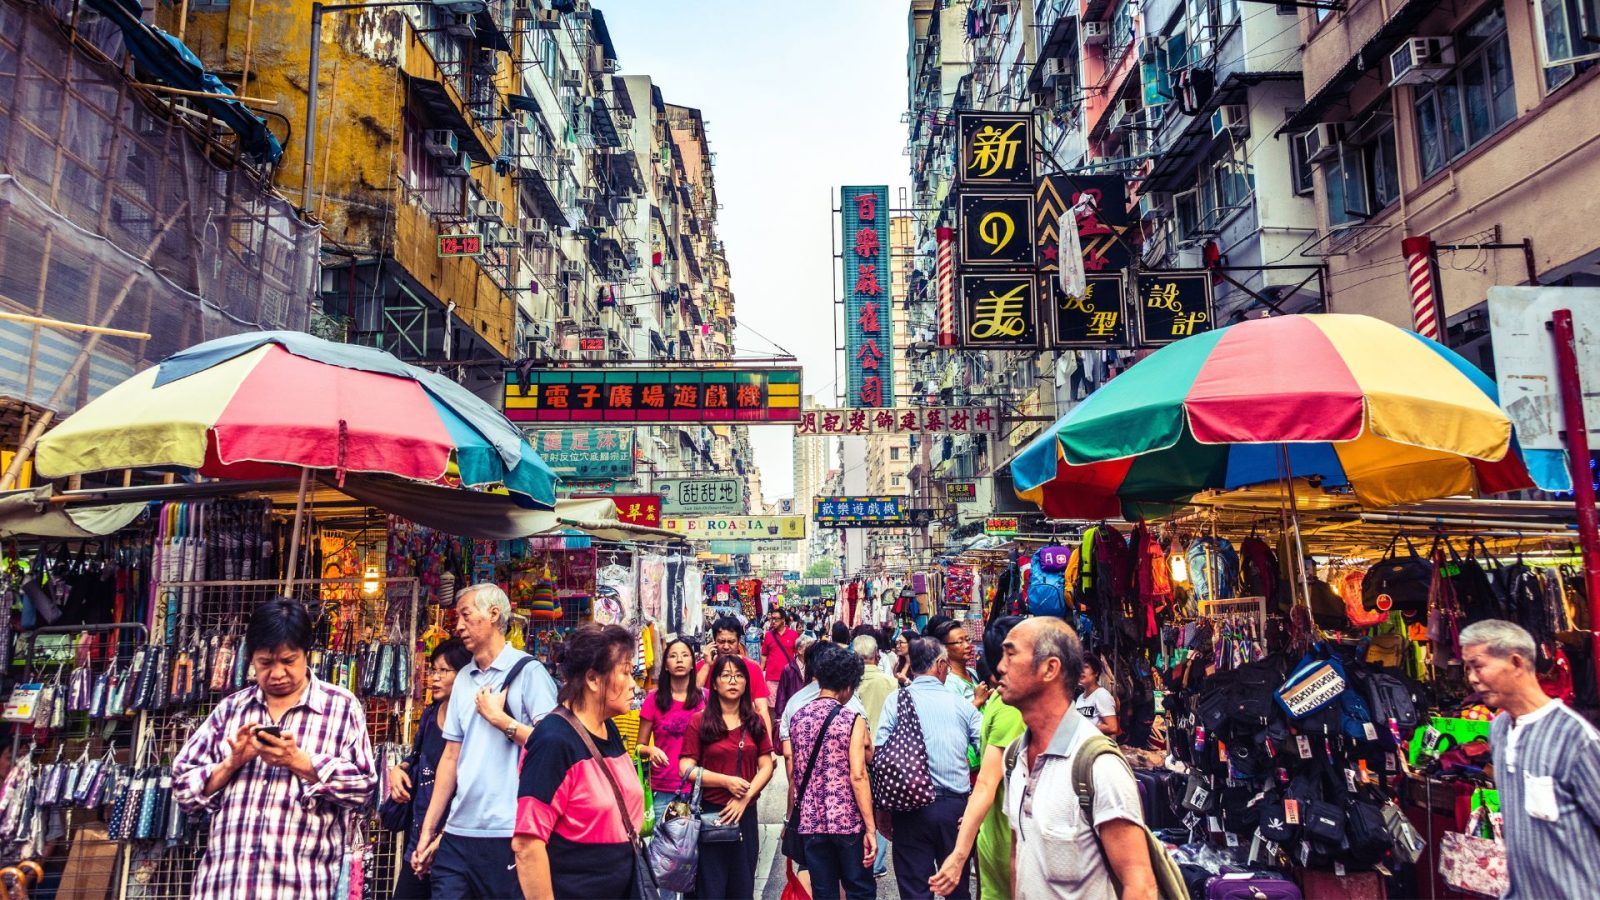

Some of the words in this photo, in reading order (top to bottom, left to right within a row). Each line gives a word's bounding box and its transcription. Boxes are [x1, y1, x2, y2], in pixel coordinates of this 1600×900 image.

[581, 339, 604, 350] 122
[545, 384, 762, 408] 電子廣場遊戲機
[798, 409, 995, 433] 明記裝飾建築材料
[683, 483, 733, 503] 甜甜地
[688, 520, 763, 530] EUROASIA
